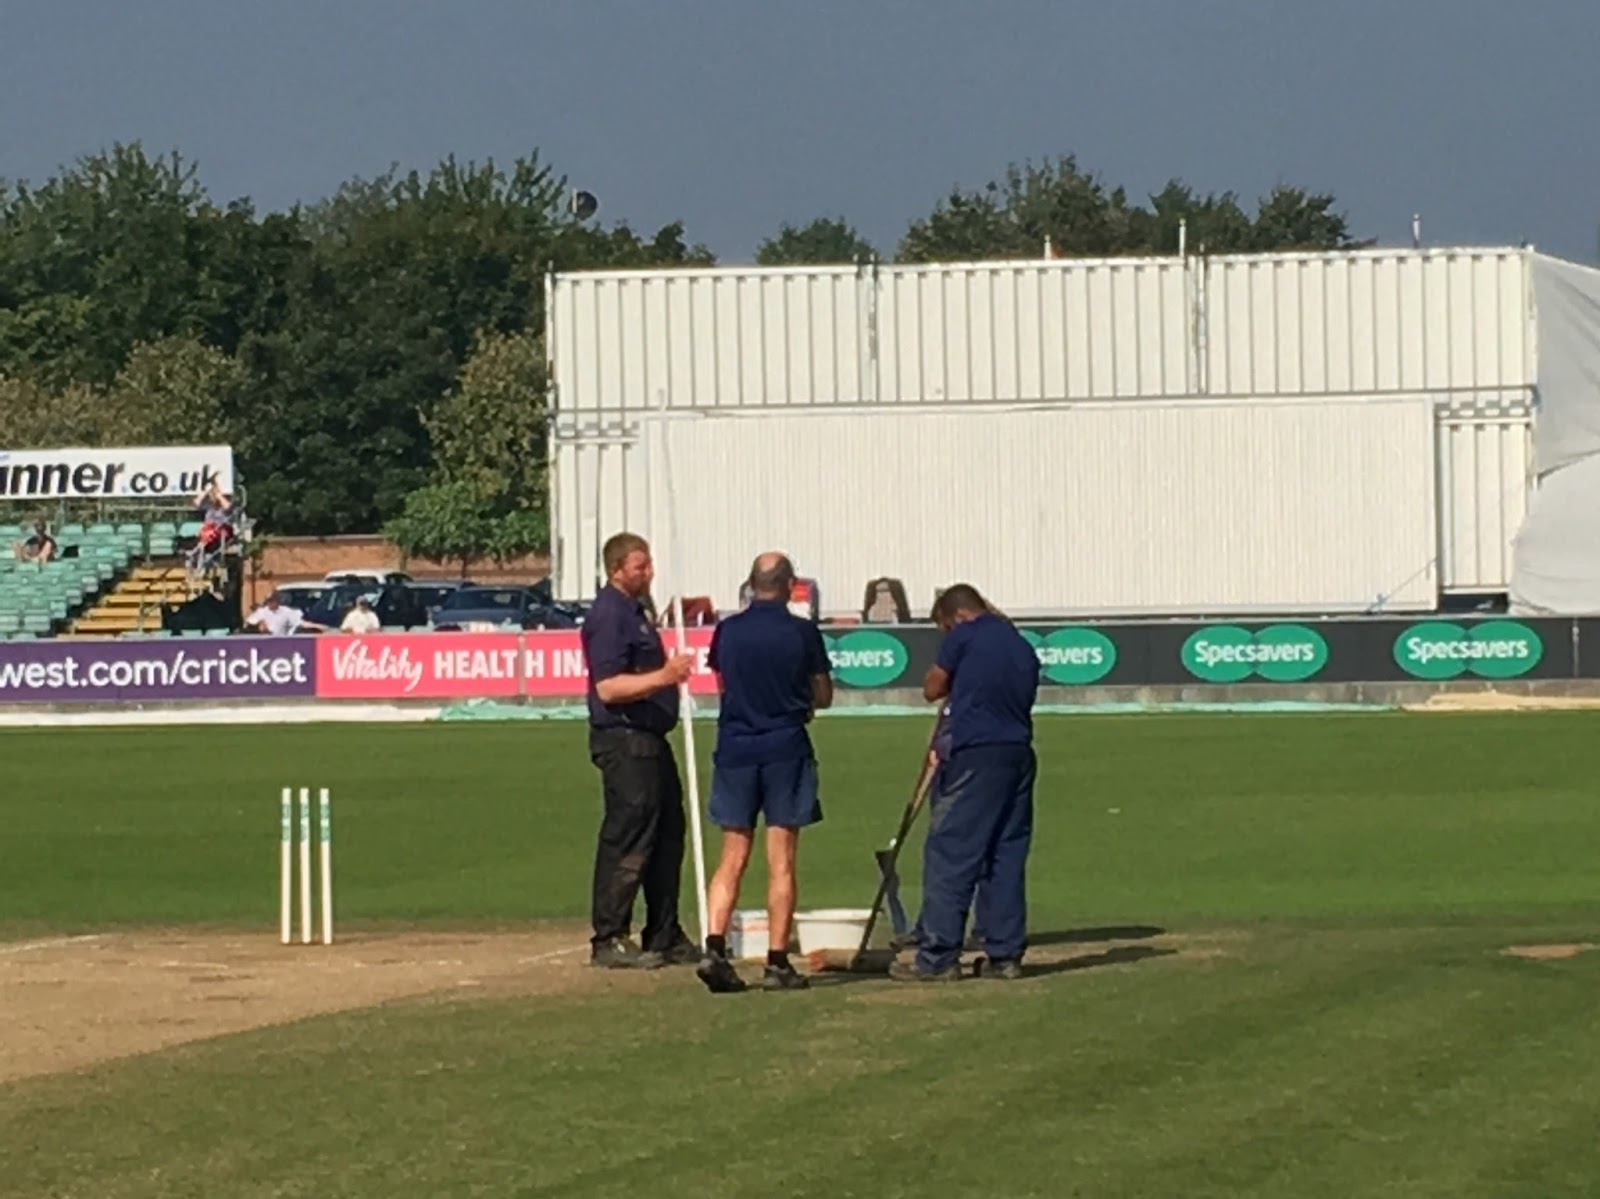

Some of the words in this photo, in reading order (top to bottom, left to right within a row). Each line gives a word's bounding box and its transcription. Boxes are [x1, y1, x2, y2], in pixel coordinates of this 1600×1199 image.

[1195, 640, 1314, 666] Specsavers
[1407, 637, 1528, 664] Specsavers
[331, 639, 423, 691] Vitality
